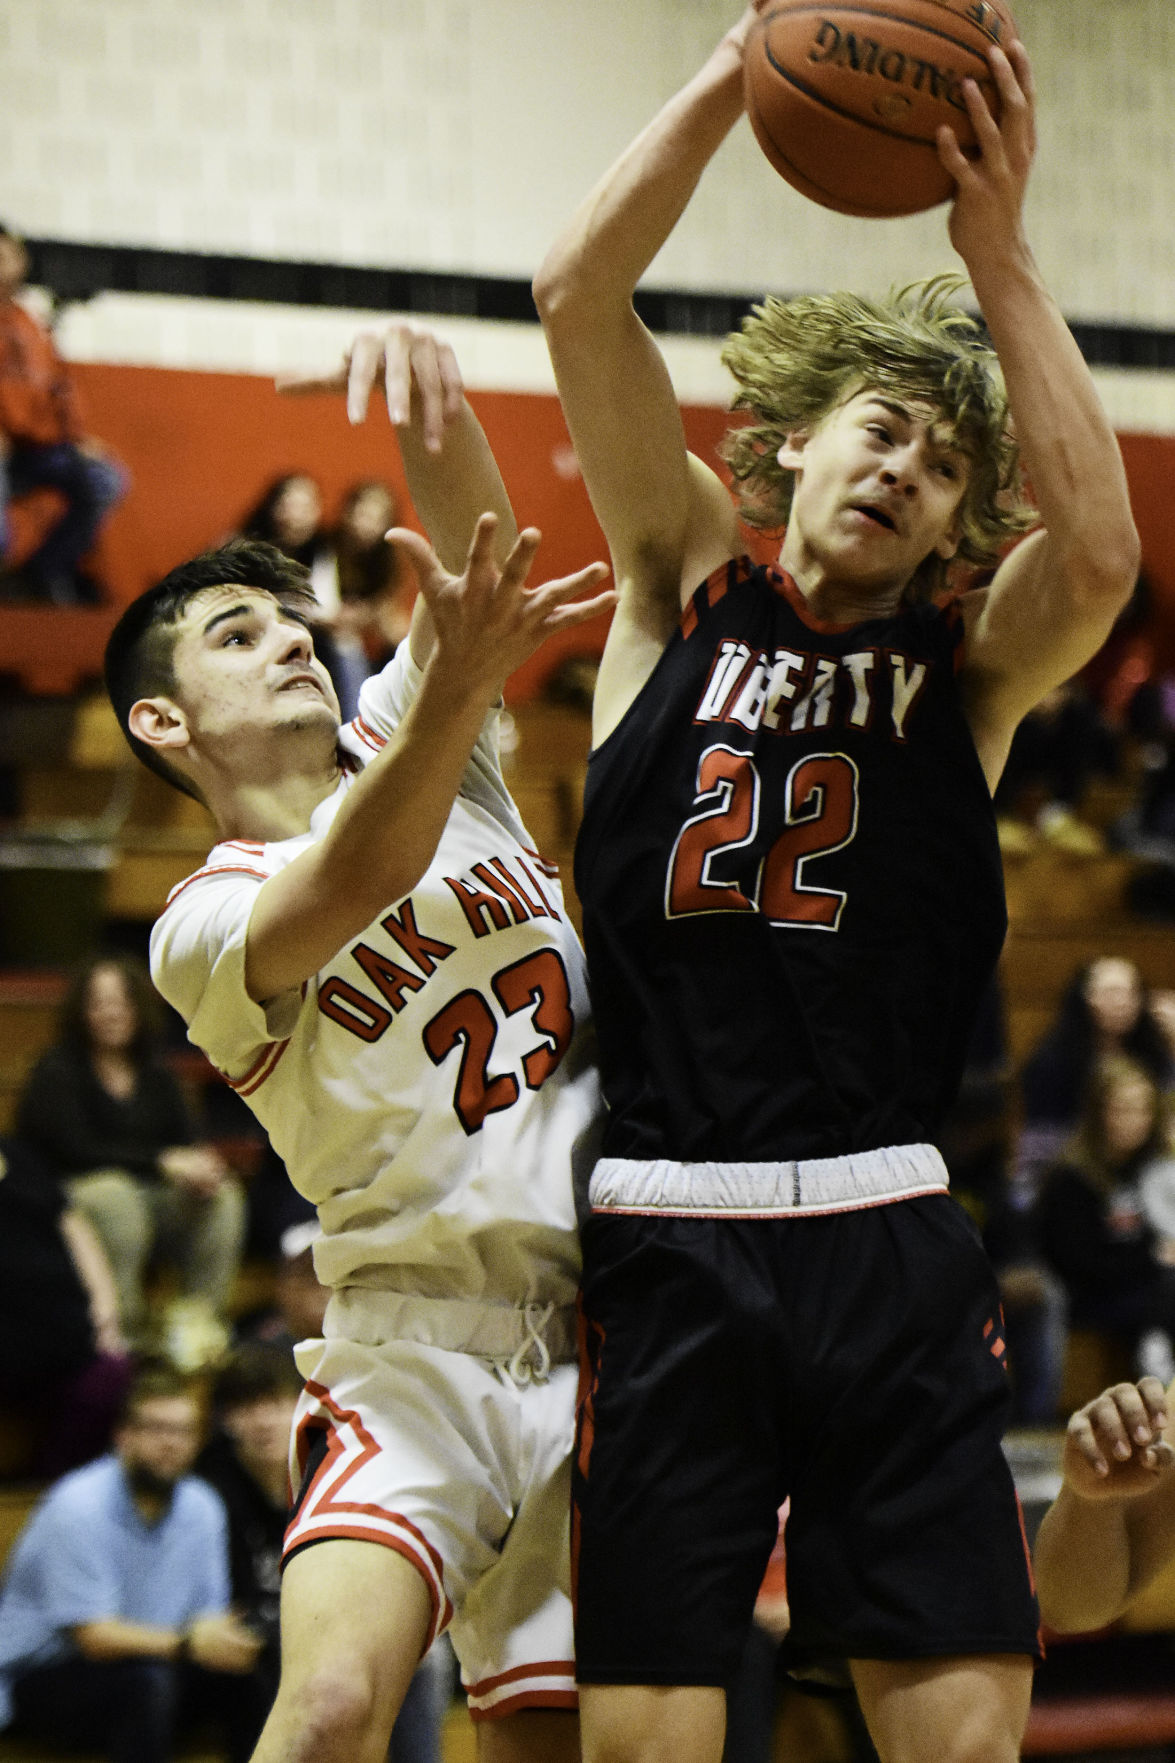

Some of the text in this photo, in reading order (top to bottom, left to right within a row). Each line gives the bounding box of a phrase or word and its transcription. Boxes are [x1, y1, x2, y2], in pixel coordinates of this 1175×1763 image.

[665, 743, 860, 932] 22
[318, 856, 562, 1043] OAK HILL
[422, 947, 575, 1136] 23
